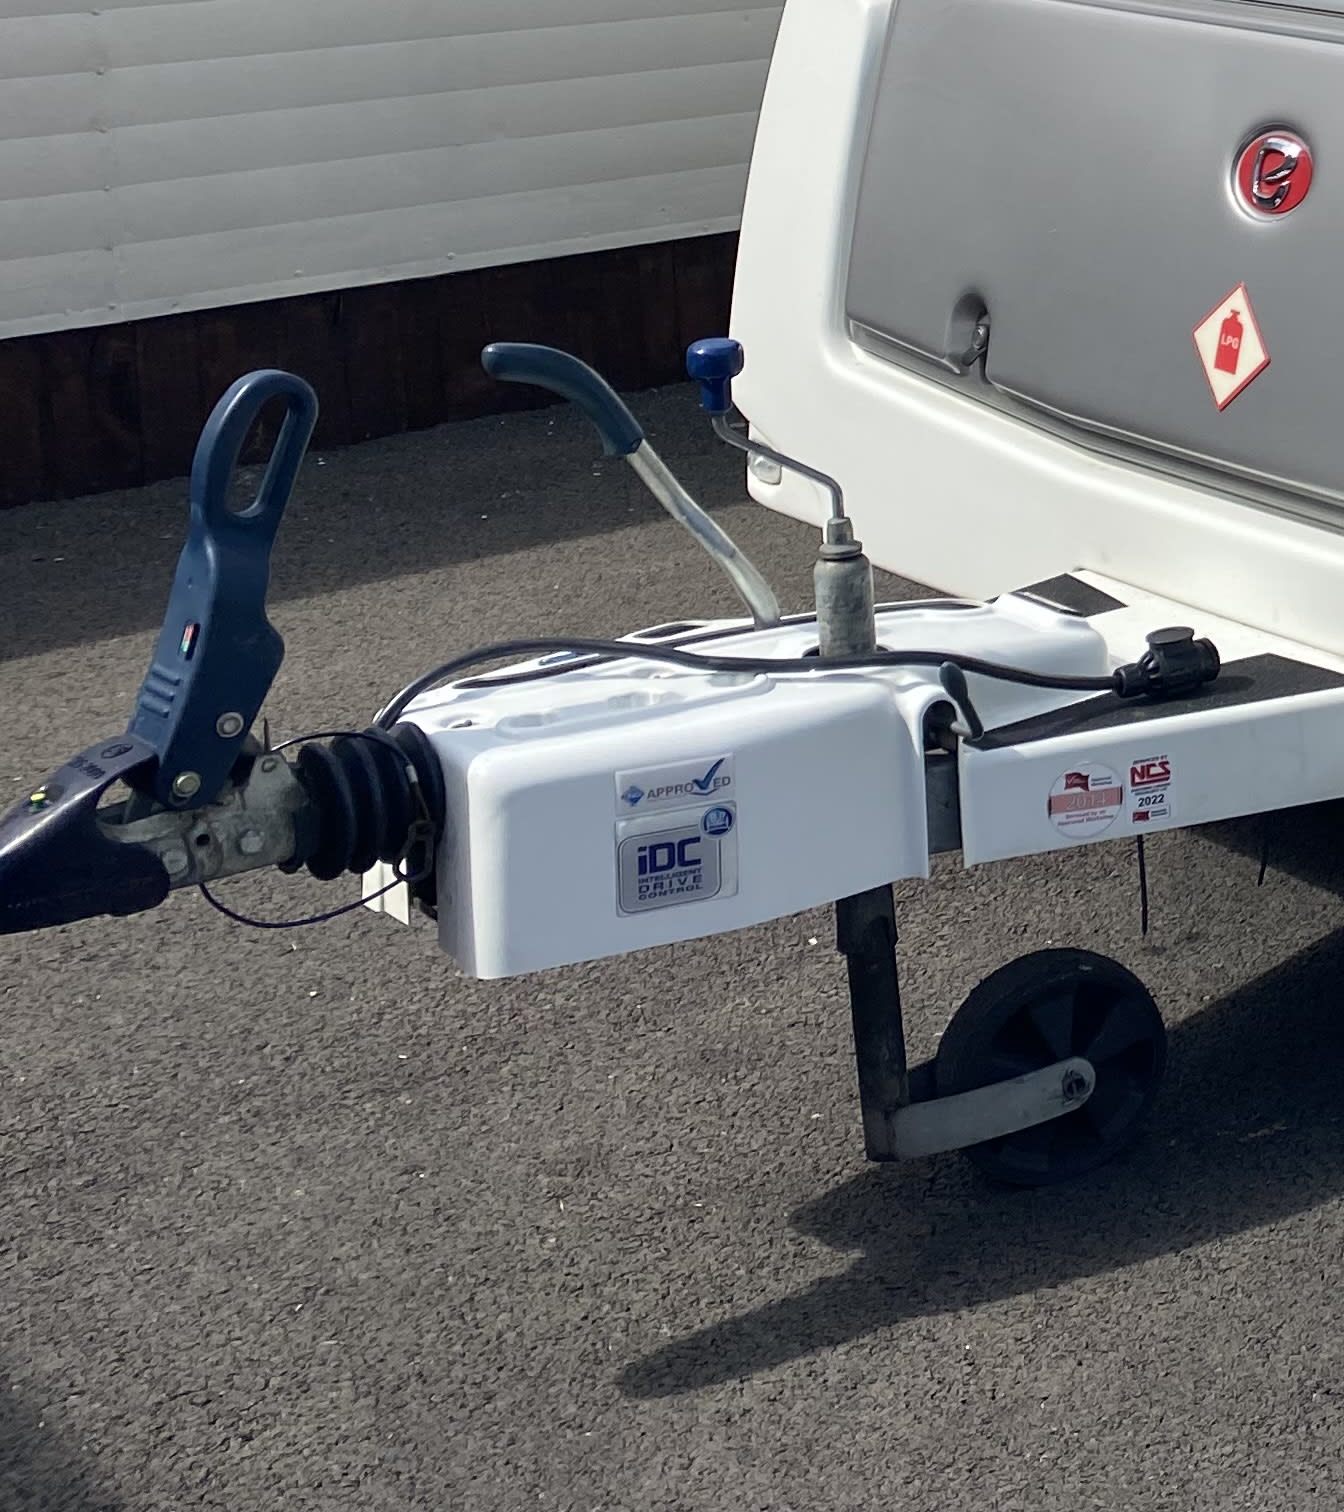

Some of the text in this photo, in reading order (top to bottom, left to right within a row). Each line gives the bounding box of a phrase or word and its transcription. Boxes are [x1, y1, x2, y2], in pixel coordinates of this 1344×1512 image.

[1220, 333, 1240, 350] LPG
[1137, 793, 1165, 808] 2022
[638, 874, 703, 894] DRIVE
[638, 884, 704, 901] CONTROL
